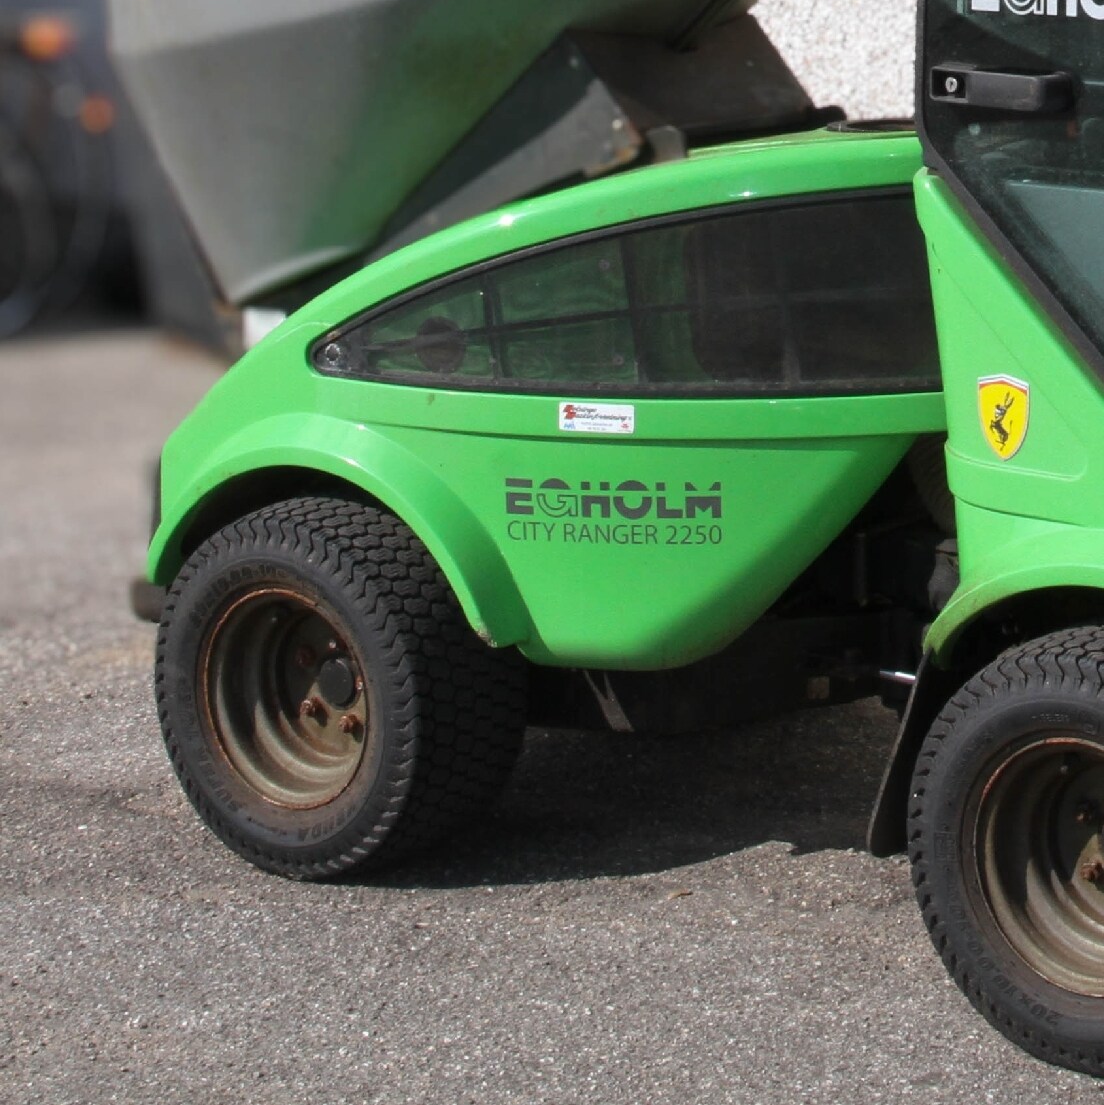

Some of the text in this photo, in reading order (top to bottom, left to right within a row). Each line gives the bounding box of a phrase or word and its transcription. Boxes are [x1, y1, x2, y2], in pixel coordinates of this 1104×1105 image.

[505, 477, 722, 520] EGHOLM
[507, 520, 722, 545] CITY RANGER 2250
